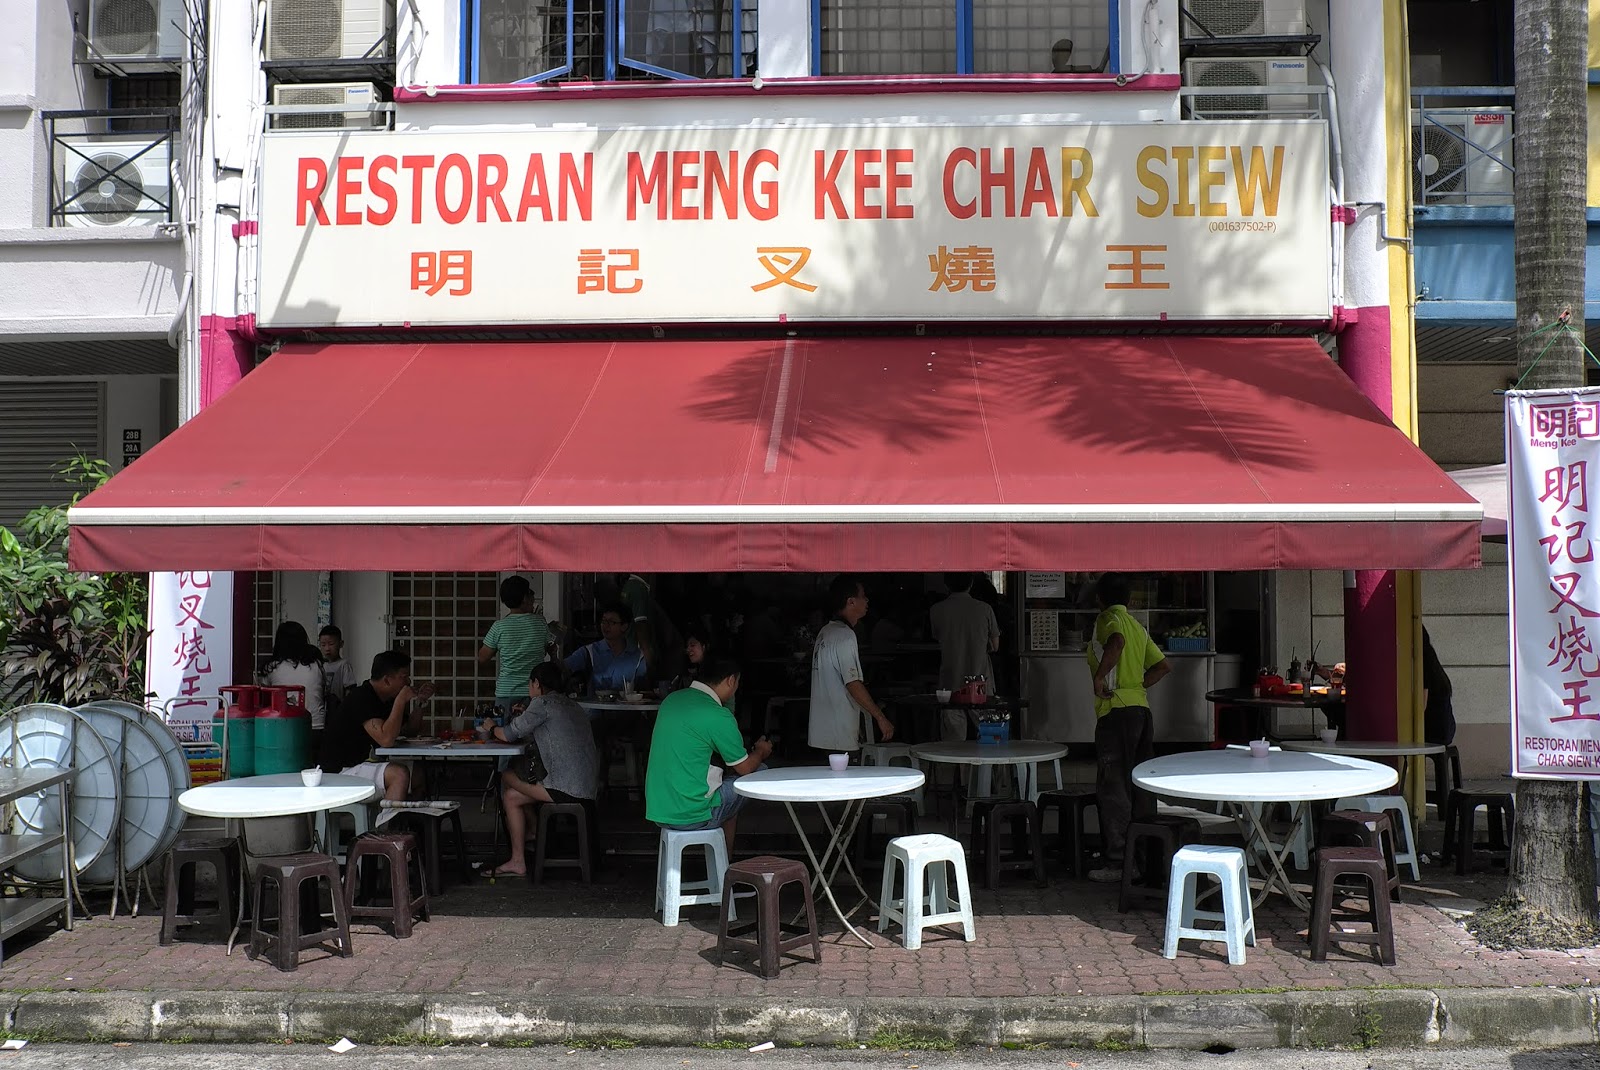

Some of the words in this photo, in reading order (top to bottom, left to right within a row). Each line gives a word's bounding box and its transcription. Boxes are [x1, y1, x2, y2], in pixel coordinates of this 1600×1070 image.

[296, 152, 593, 227] RESTORAN
[627, 149, 778, 222] MENG
[815, 149, 914, 220] KEE
[943, 147, 1098, 219] CHAR
[1137, 145, 1285, 219] SIEW
[1208, 221, 1277, 234] (001637502-P)
[410, 245, 1170, 297] 明記叉燒王
[1530, 438, 1558, 450] Meng
[1561, 438, 1577, 448] Kee
[1537, 460, 1600, 724] 明记叉烧王
[1525, 736, 1578, 752] RESTORAN
[1537, 753, 1565, 767] CHAR
[1567, 754, 1592, 768] SIEW
